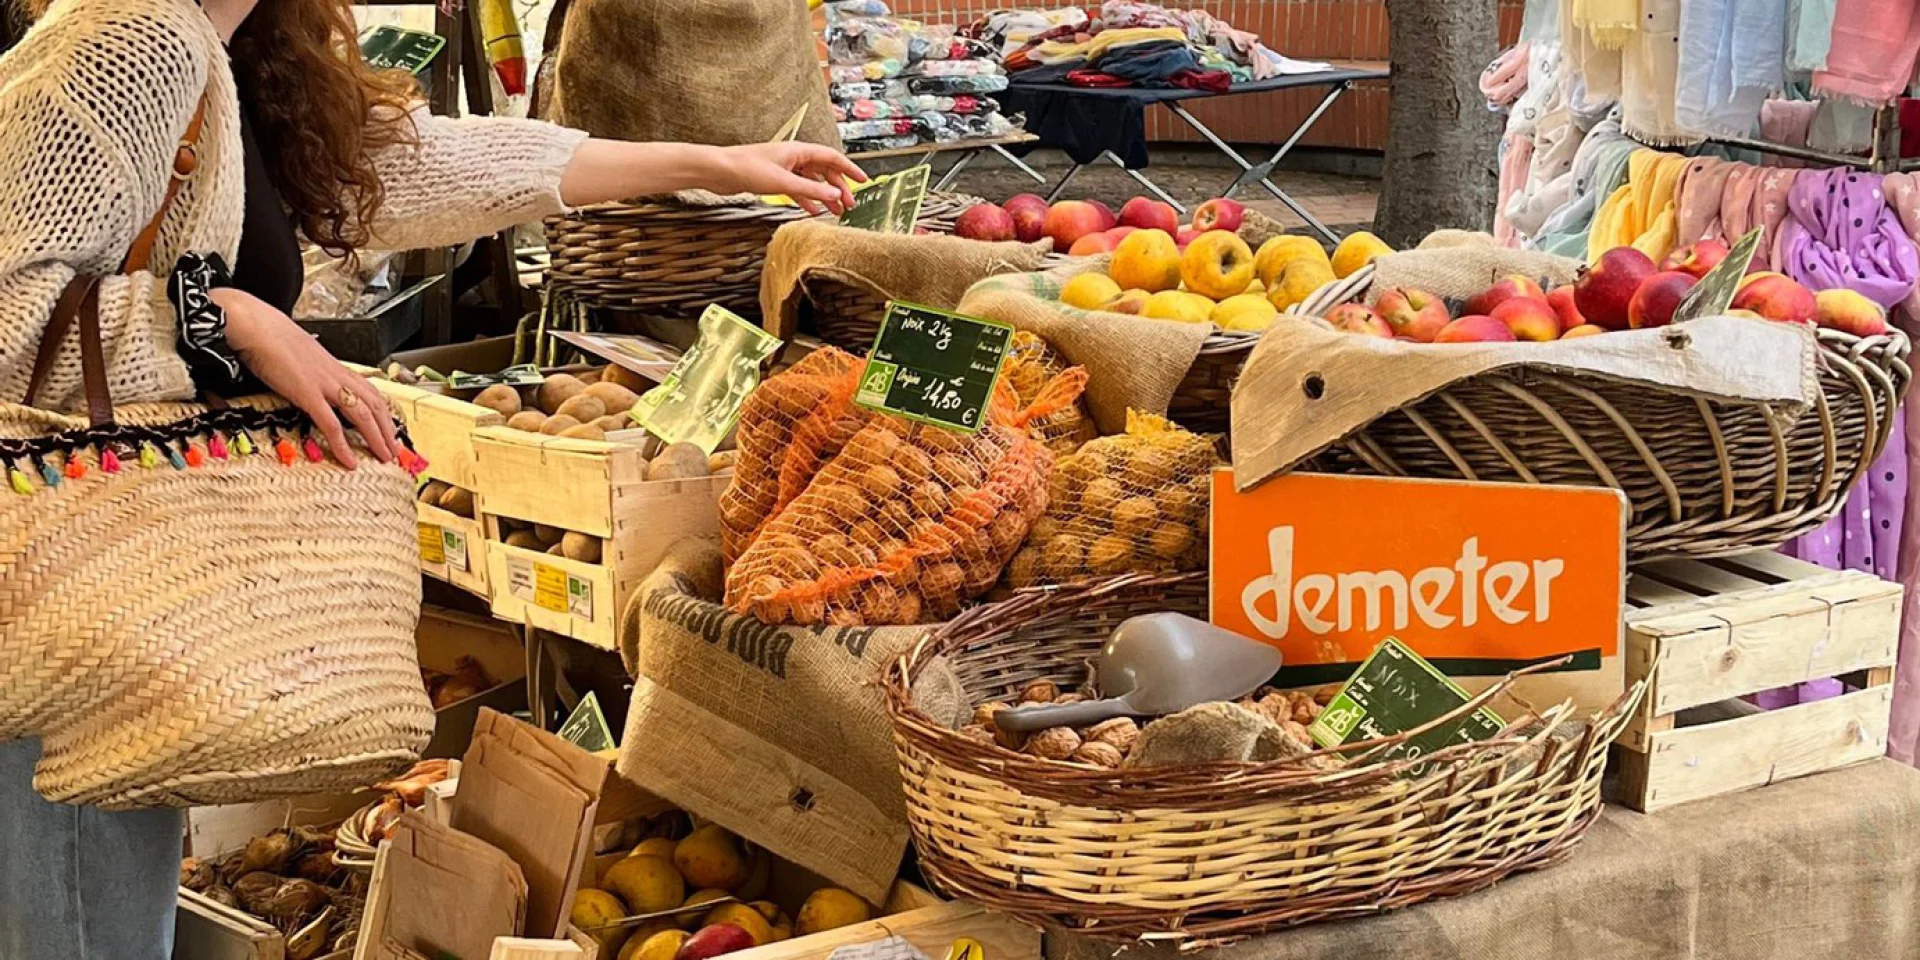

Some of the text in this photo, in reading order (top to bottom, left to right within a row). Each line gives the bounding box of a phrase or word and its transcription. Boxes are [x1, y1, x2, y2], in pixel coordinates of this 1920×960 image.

[901, 317, 925, 332] Noix
[863, 371, 887, 393] AB
[962, 408, 977, 425] €
[1241, 525, 1565, 639] demeter
[1323, 709, 1353, 733] AB
